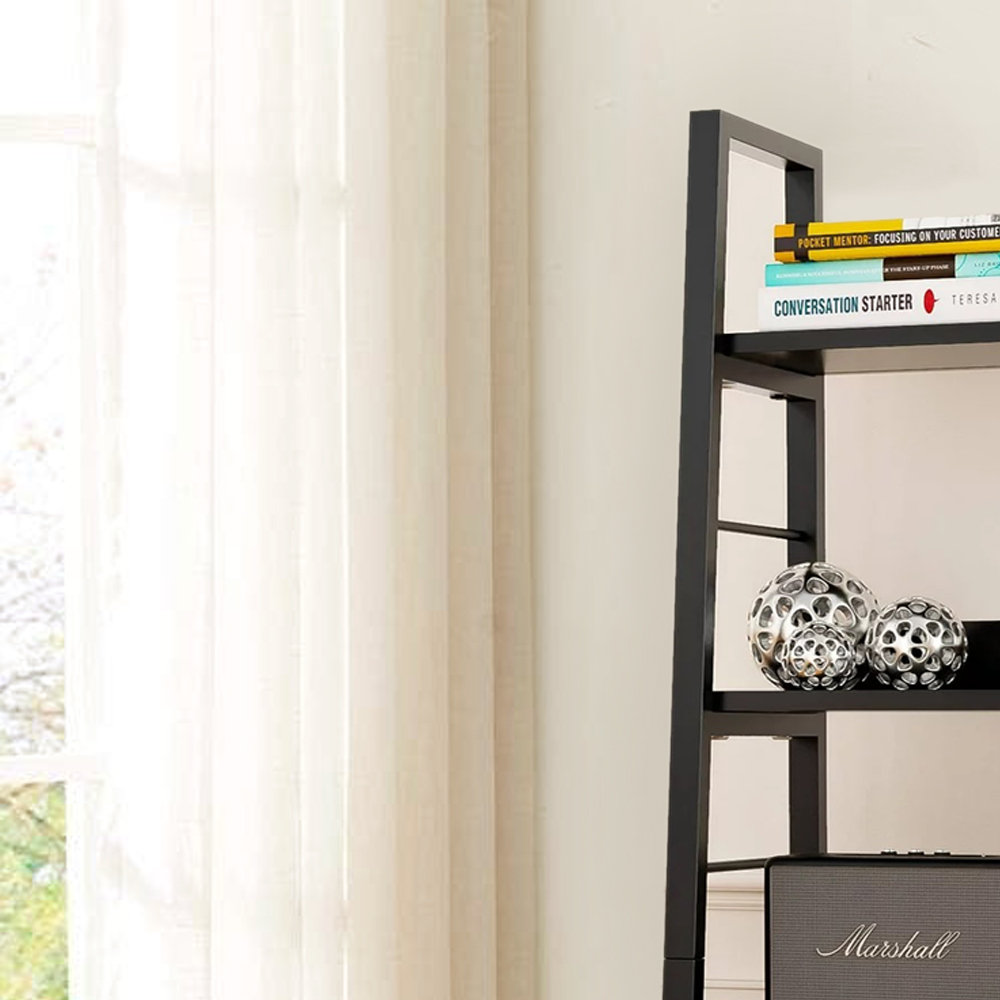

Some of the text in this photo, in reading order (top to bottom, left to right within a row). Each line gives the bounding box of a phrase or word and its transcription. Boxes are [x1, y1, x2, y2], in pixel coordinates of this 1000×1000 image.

[798, 237, 832, 250] POCKET
[833, 234, 872, 247] MENTOR:
[874, 231, 917, 245] FOCUSING
[919, 230, 931, 243] ON
[933, 228, 957, 242] YOUR
[774, 296, 859, 318] CONVERSATION
[861, 293, 913, 312] STARTER
[952, 292, 997, 306] TERESA
[816, 922, 960, 960] Marshall
